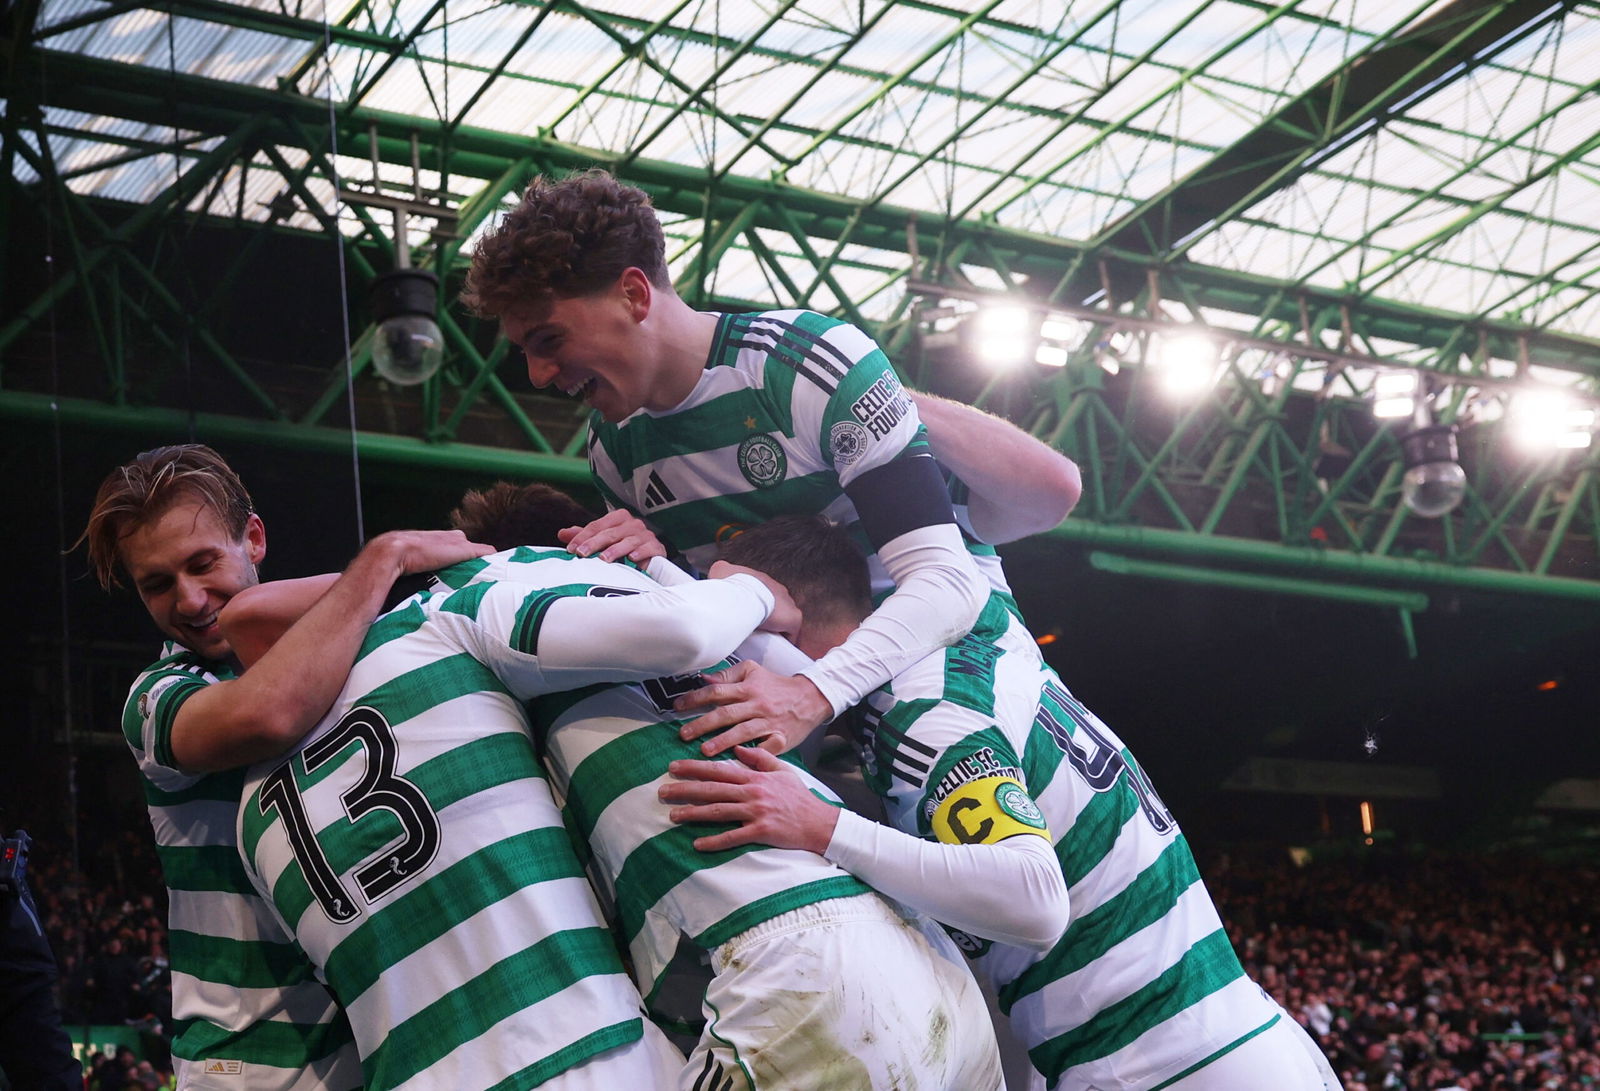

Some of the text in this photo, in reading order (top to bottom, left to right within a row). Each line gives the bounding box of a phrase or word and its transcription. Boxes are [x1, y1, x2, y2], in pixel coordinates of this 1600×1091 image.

[851, 379, 893, 424] CELTIC
[973, 747, 999, 770] FC
[259, 706, 441, 924] 13
[947, 797, 995, 845] C
